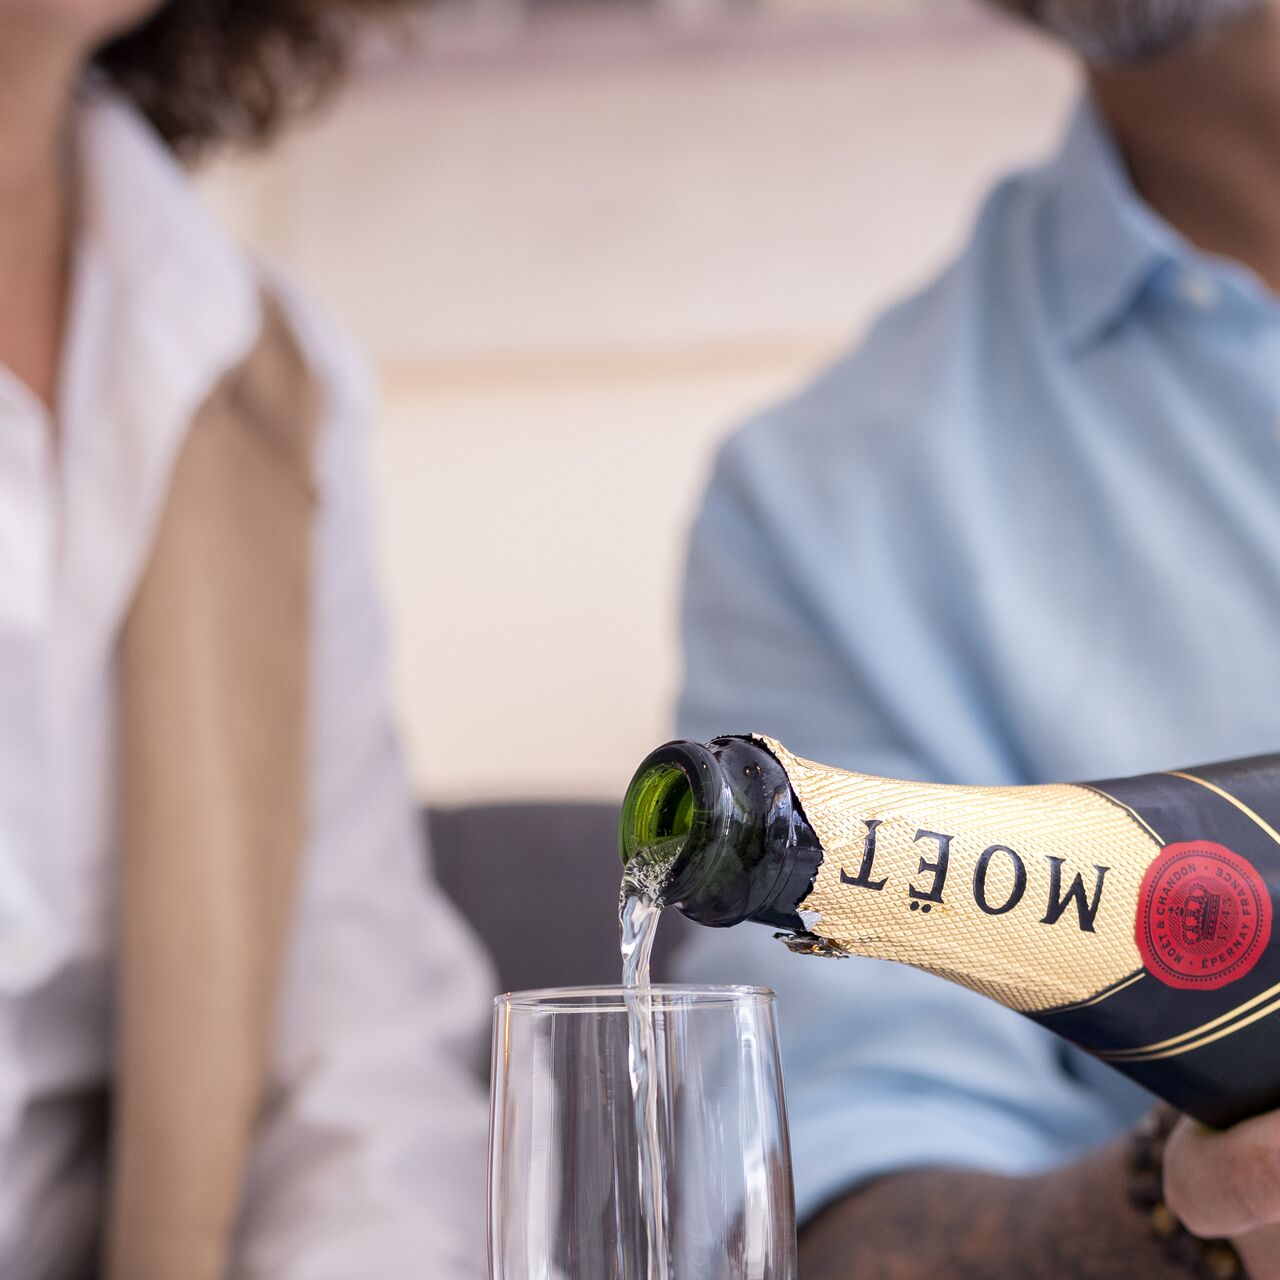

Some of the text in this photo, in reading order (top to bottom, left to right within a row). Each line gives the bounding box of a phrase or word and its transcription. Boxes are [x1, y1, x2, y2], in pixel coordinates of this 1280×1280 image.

[840, 819, 1111, 933] MOËT
[1157, 864, 1197, 915] CHANDON
[1215, 867, 1251, 917] FRANCE
